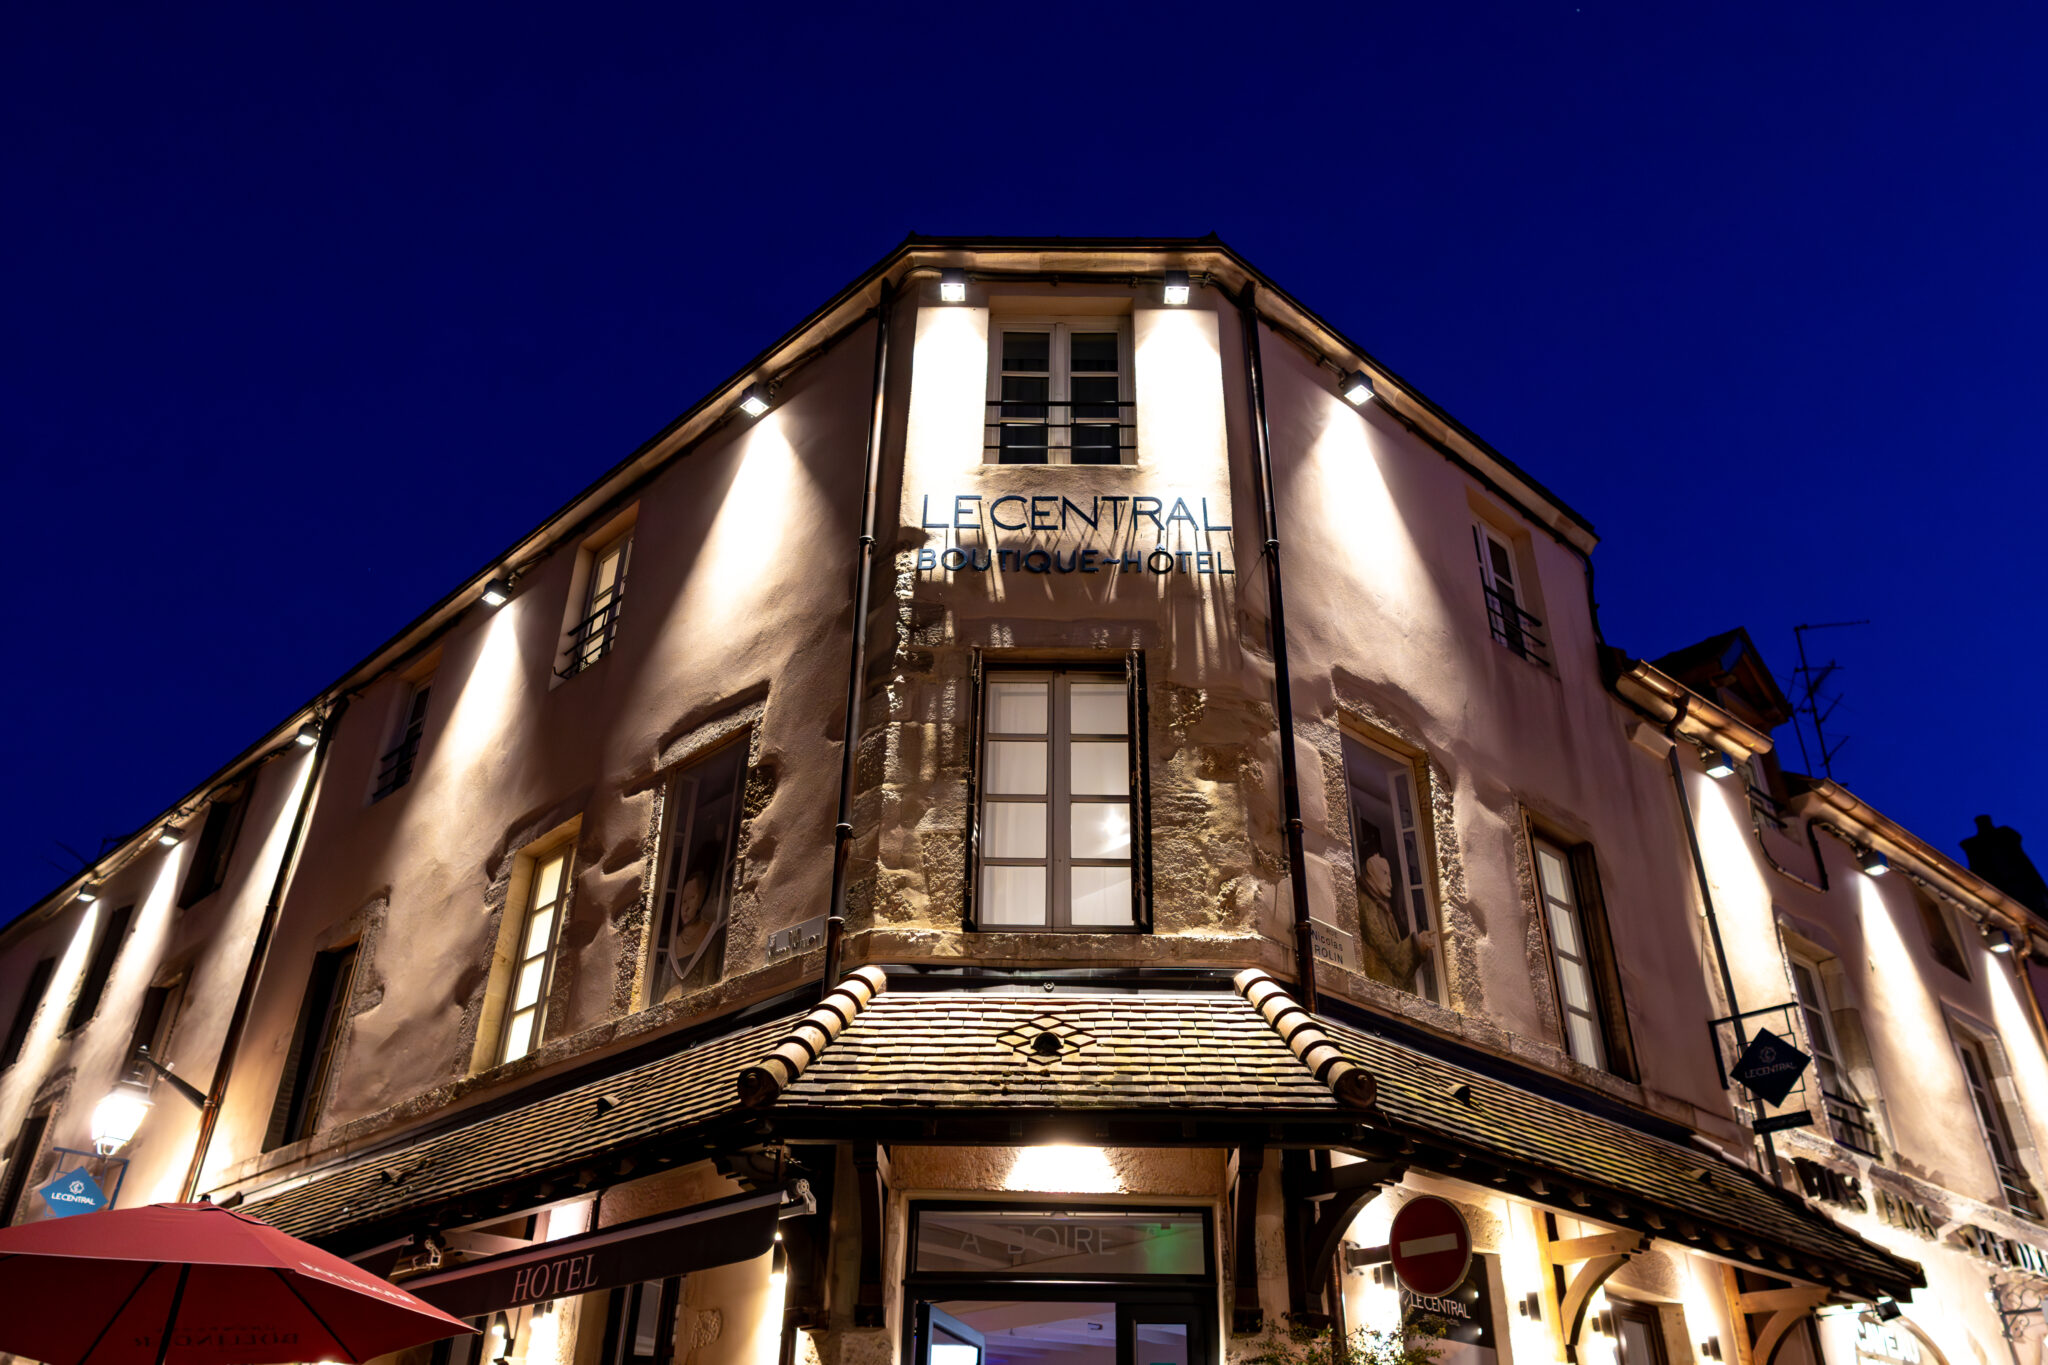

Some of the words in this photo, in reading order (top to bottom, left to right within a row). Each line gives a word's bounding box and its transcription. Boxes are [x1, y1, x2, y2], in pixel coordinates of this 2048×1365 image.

[921, 494, 982, 529] LE
[989, 495, 1232, 531] CENTRAL
[1311, 930, 1343, 952] Nicolas
[1314, 944, 1344, 965] ROLIN
[62, 1194, 96, 1206] CENTRAL
[1007, 1226, 1118, 1255] BOIRE
[510, 1254, 599, 1303] HOTEL
[1424, 1296, 1472, 1319] CENTRAL
